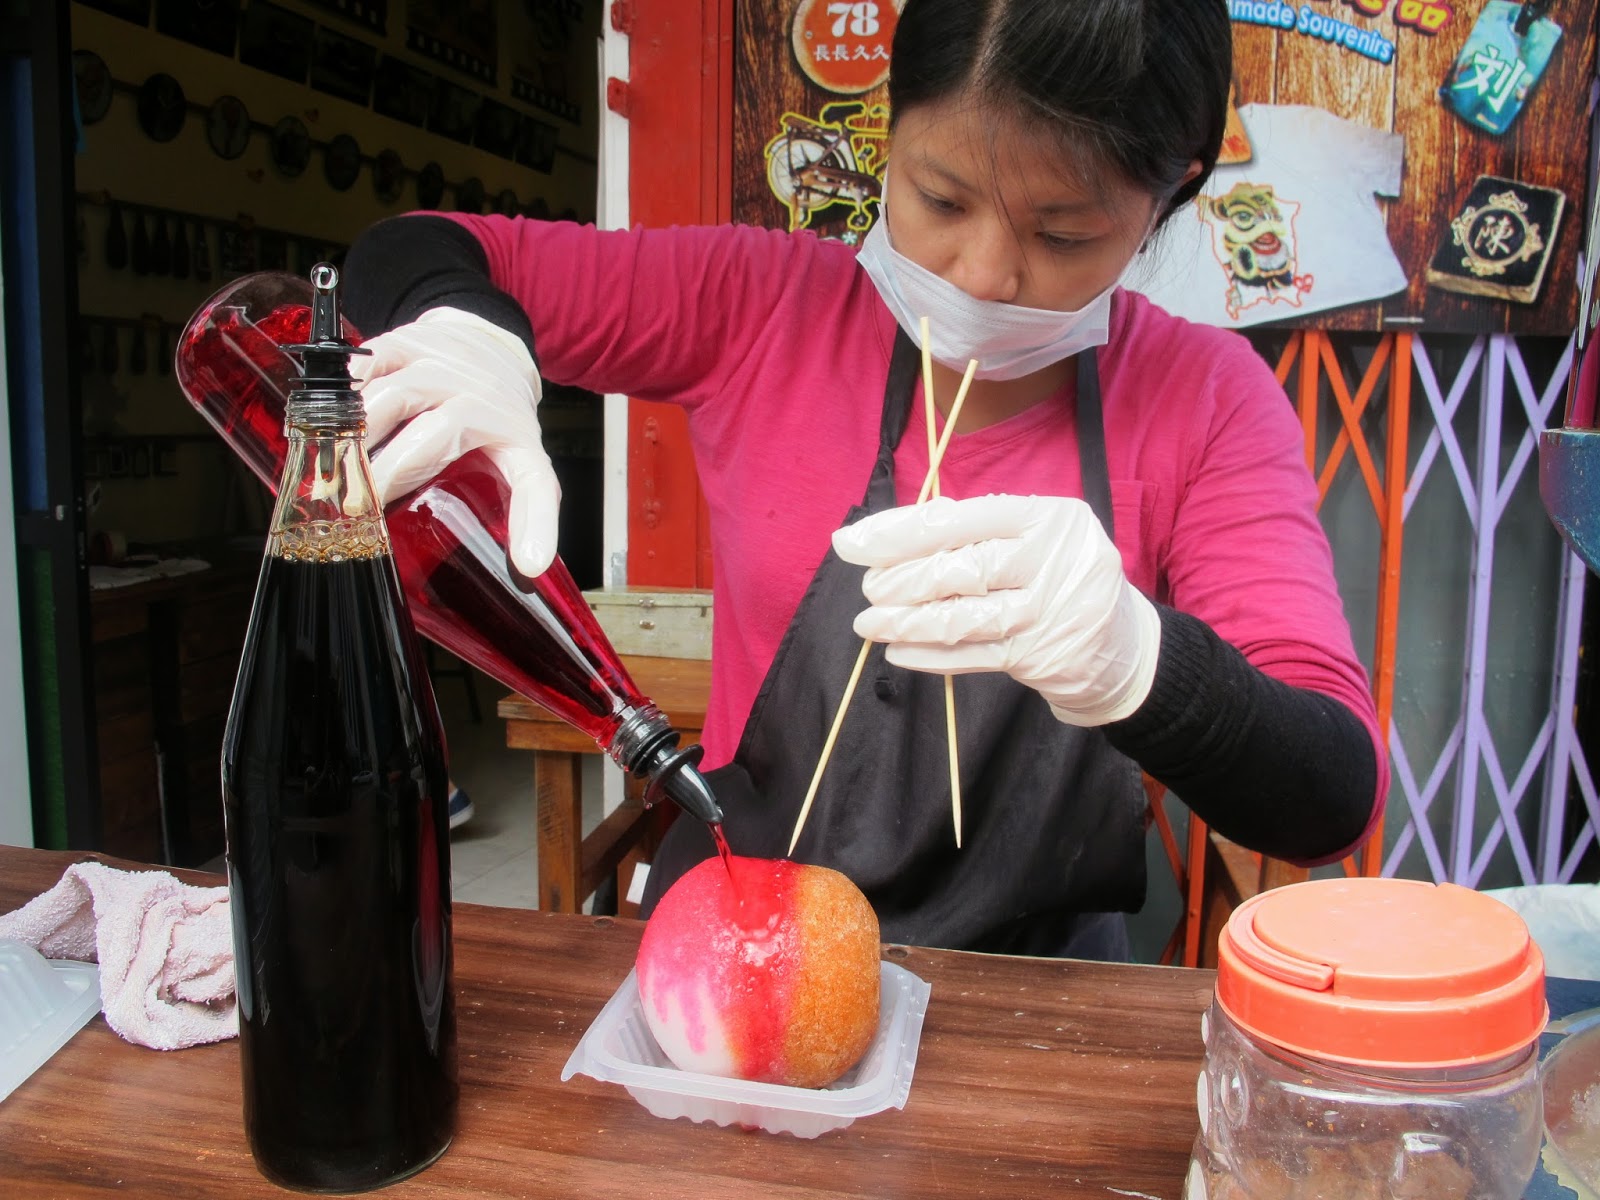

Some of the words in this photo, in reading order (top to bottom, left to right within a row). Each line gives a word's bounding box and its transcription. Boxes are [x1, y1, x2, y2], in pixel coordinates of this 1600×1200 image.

[826, 2, 880, 38] 78
[1227, 0, 1295, 25] made
[1298, 8, 1392, 59] Souvenirs
[813, 44, 890, 61] 長長久久
[1452, 44, 1526, 113] 刘
